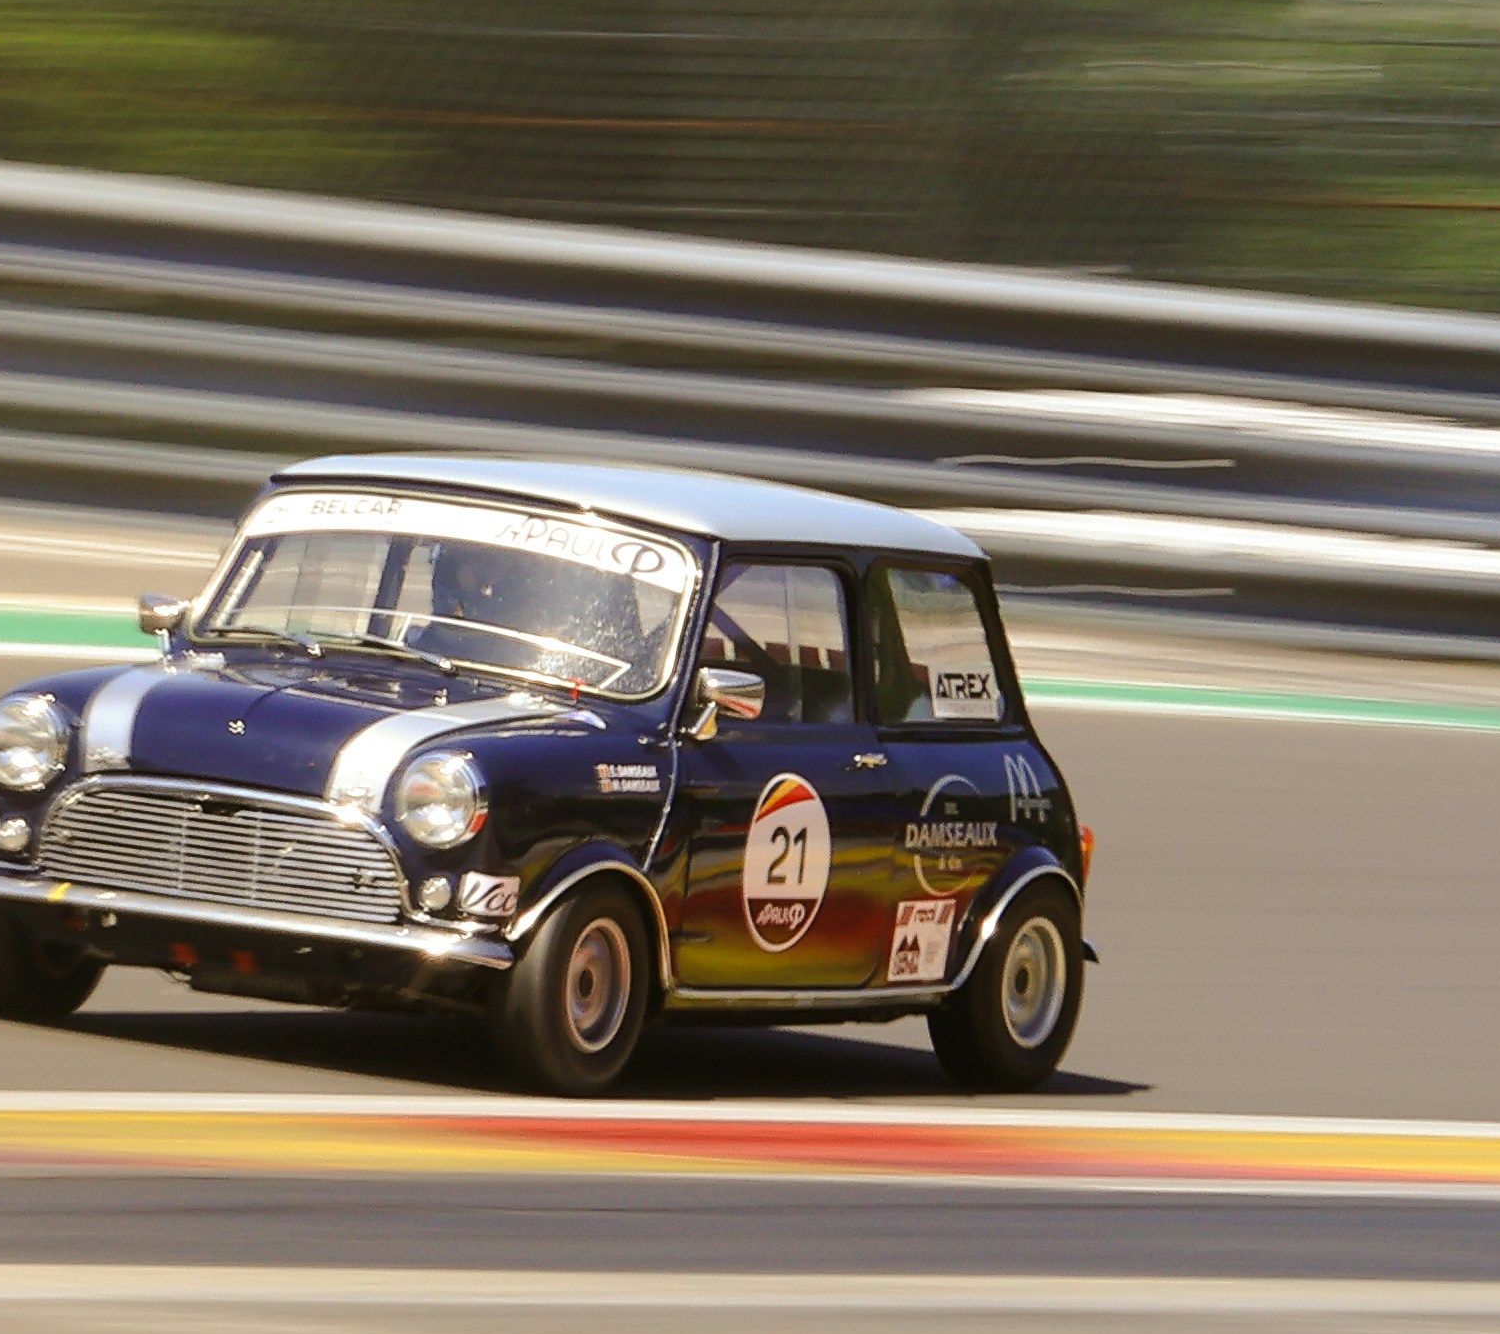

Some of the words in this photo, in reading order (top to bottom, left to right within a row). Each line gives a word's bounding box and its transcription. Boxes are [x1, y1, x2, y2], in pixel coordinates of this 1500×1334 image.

[310, 498, 402, 516] BELCAR
[521, 515, 603, 561] PAUL
[936, 673, 991, 699] ATREX
[904, 821, 998, 848] DAMSEAUX
[766, 825, 808, 886] 21
